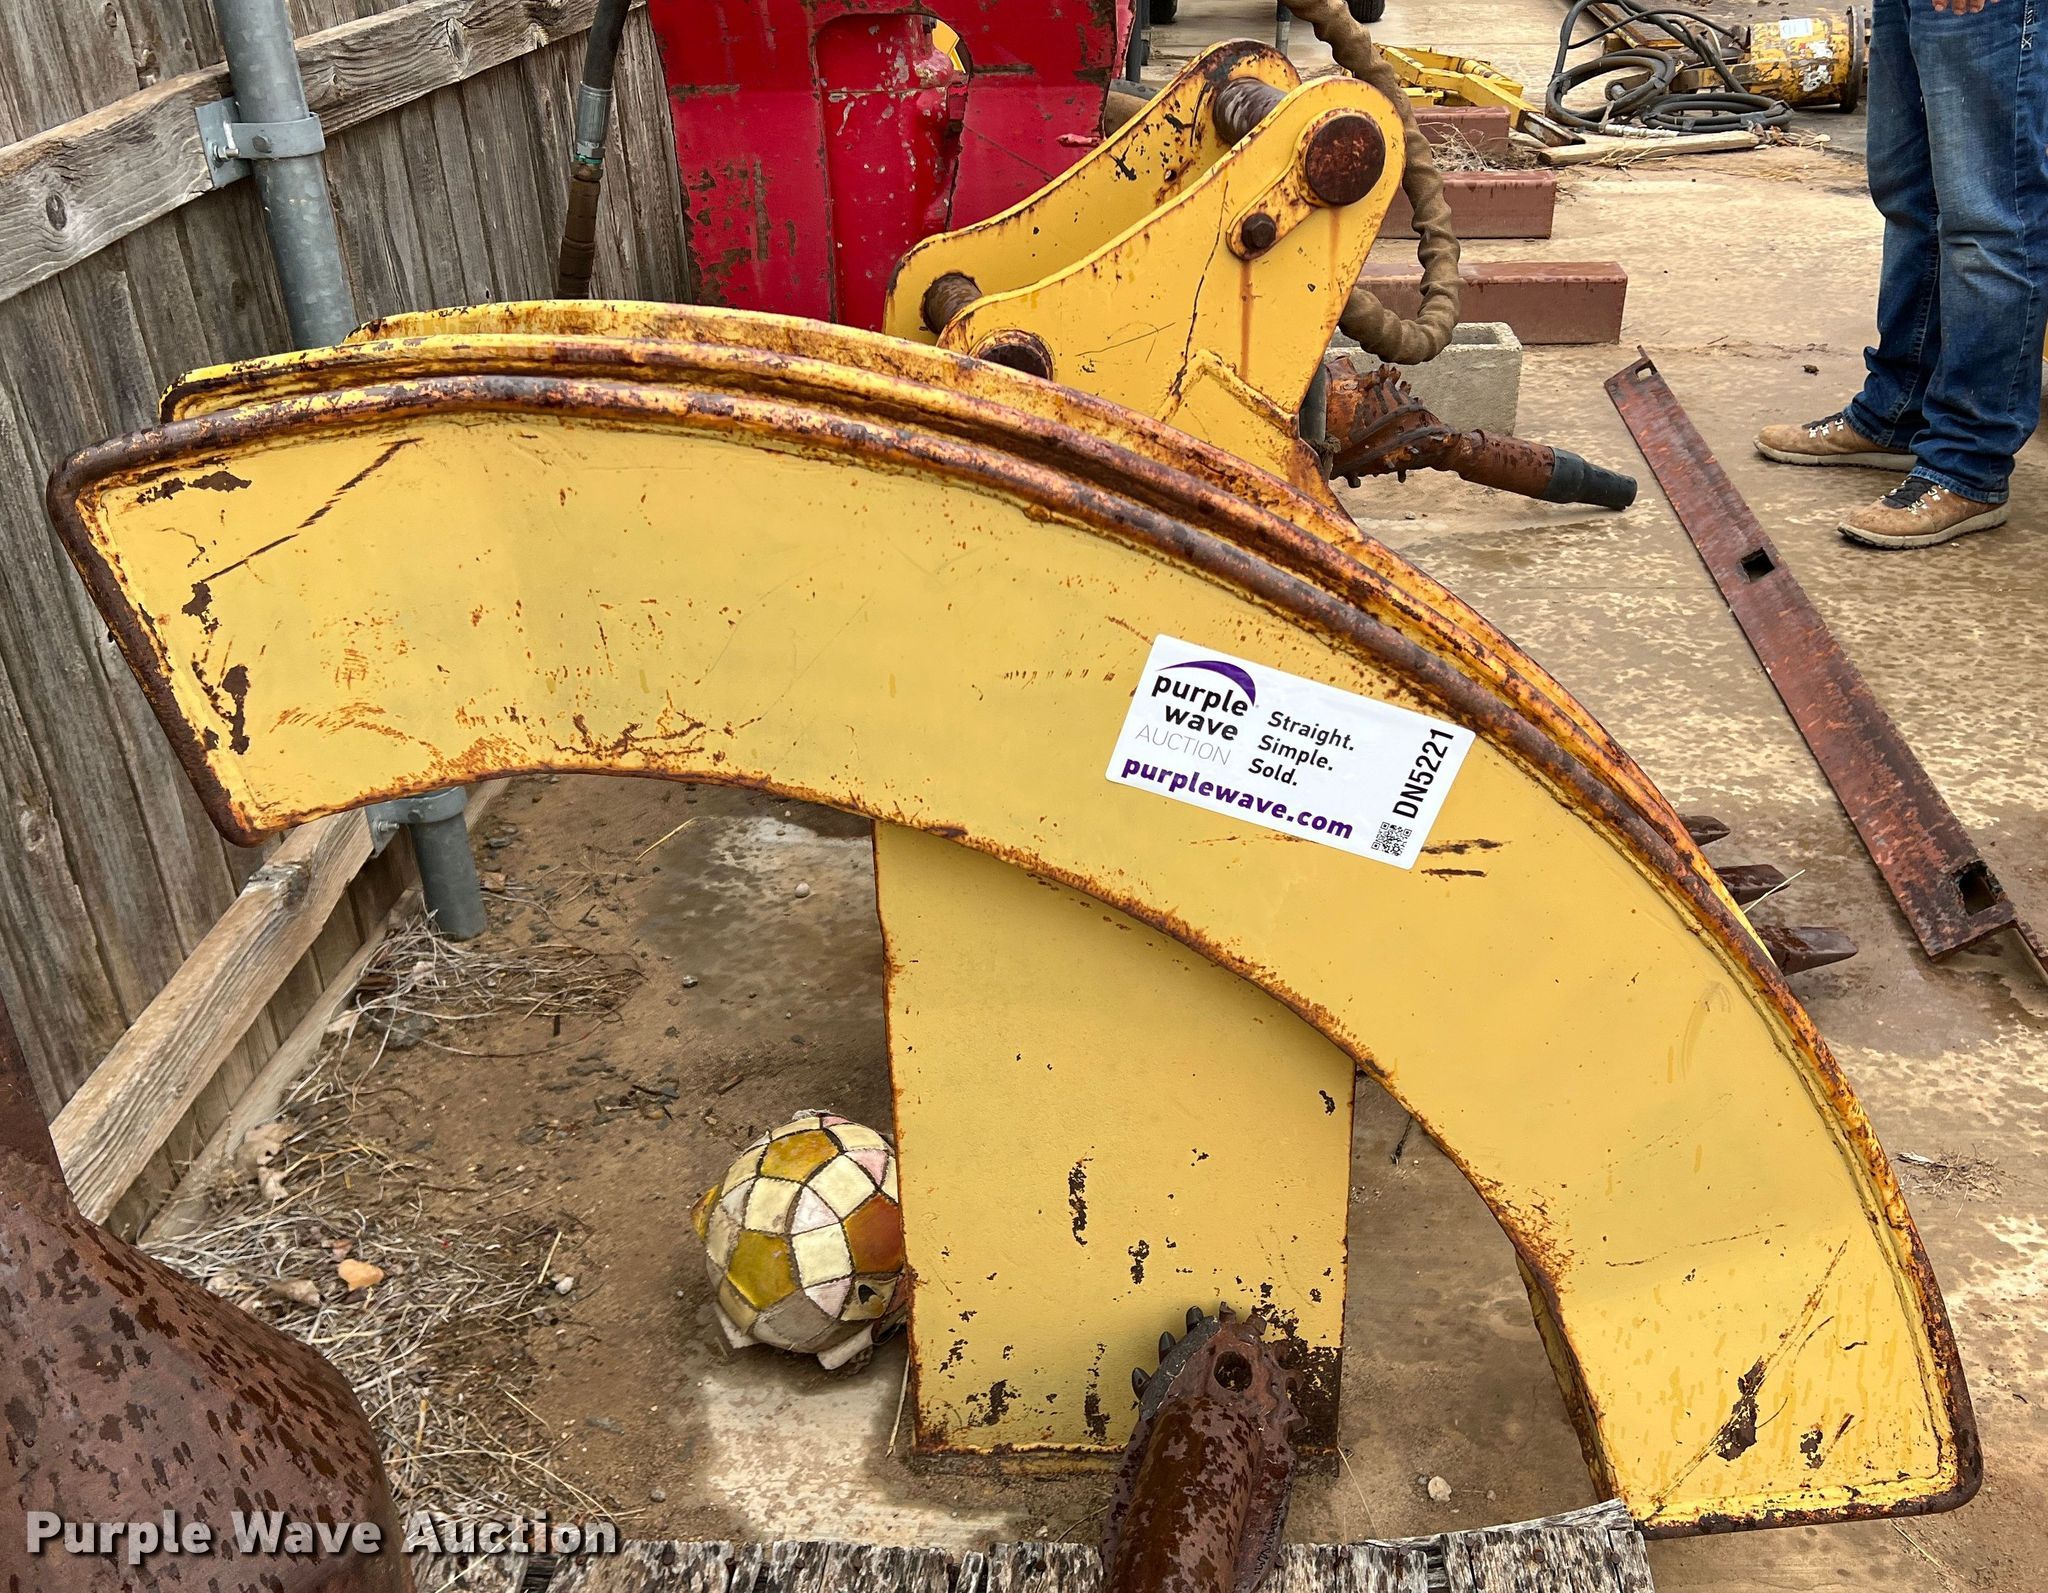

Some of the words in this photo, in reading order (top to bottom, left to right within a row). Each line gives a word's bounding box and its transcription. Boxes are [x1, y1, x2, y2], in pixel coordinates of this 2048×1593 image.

[1151, 674, 1248, 717] purple
[1164, 704, 1238, 742] wave
[1267, 711, 1354, 751] Straight.
[1135, 724, 1232, 766] AUCTION
[1257, 735, 1334, 771] Simple.
[1248, 758, 1298, 787] Sold.
[1392, 728, 1454, 819] DN5221
[1121, 758, 1353, 839] purplewave.com
